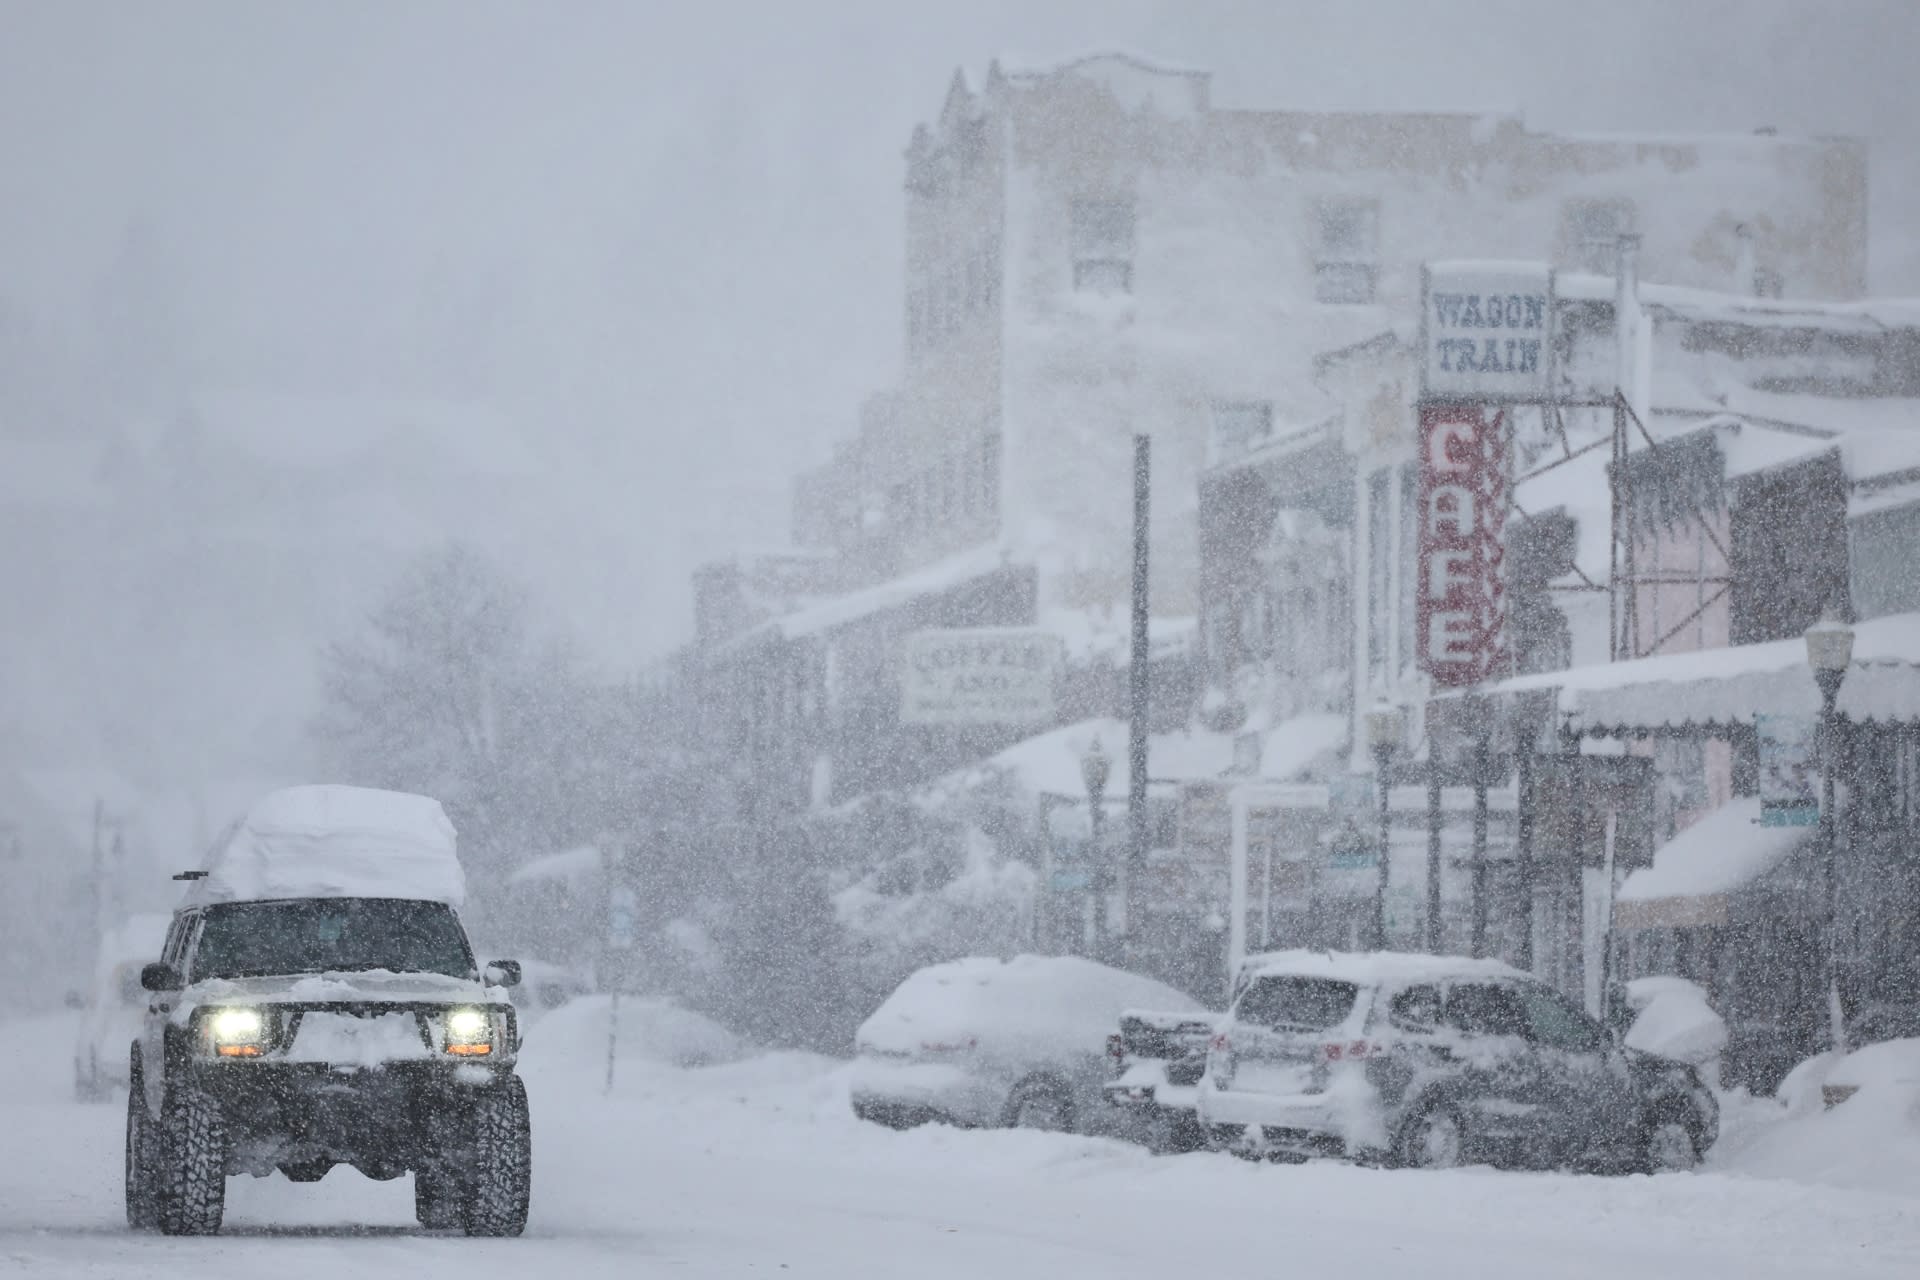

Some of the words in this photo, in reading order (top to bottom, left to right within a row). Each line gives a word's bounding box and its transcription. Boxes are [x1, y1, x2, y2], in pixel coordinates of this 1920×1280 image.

[1433, 294, 1545, 328] WAGON
[1438, 338, 1541, 373] TRAIN
[1429, 421, 1475, 663] CAFE
